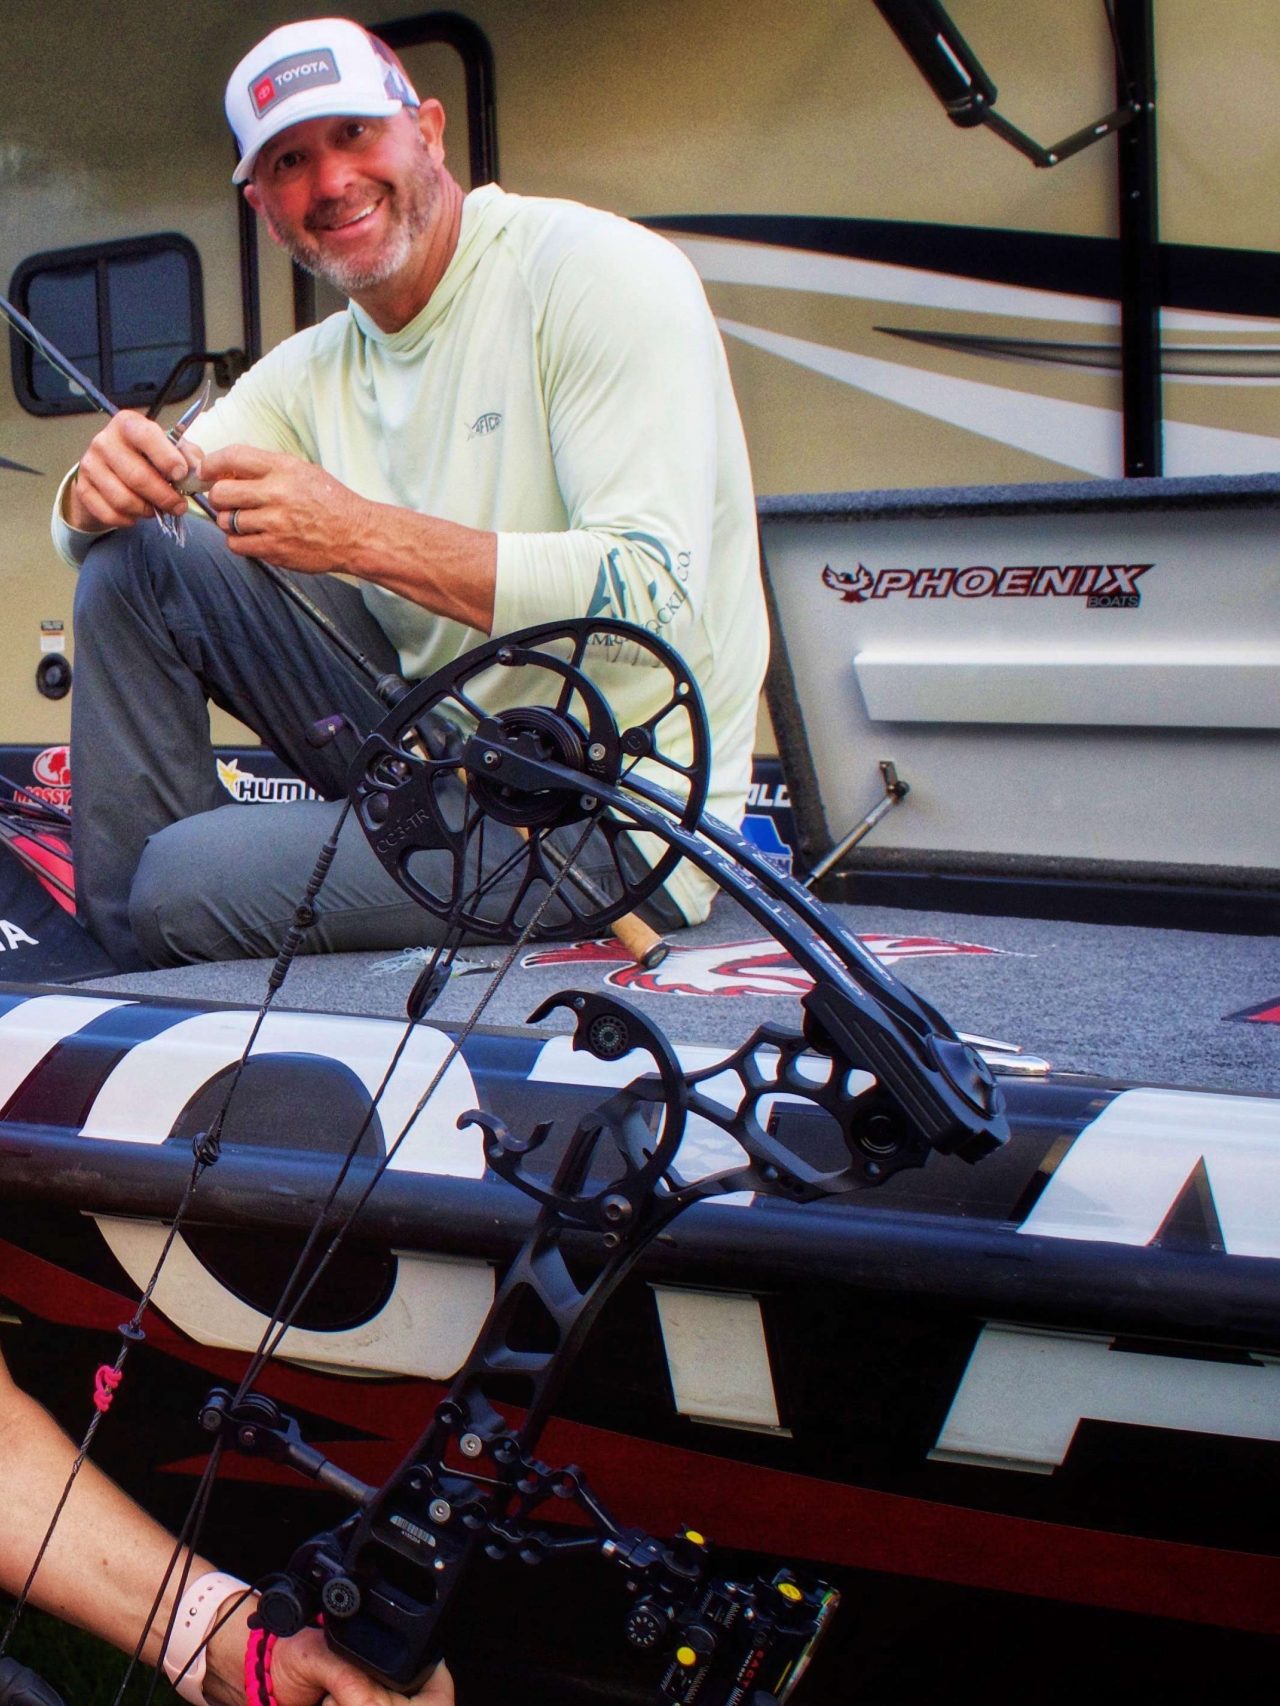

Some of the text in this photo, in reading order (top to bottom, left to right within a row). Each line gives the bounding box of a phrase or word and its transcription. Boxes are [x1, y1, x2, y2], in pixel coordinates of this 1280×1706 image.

[274, 60, 330, 87] TOYOTA
[871, 563, 1157, 600] PHOENIX
[1088, 596, 1140, 608] BOATS
